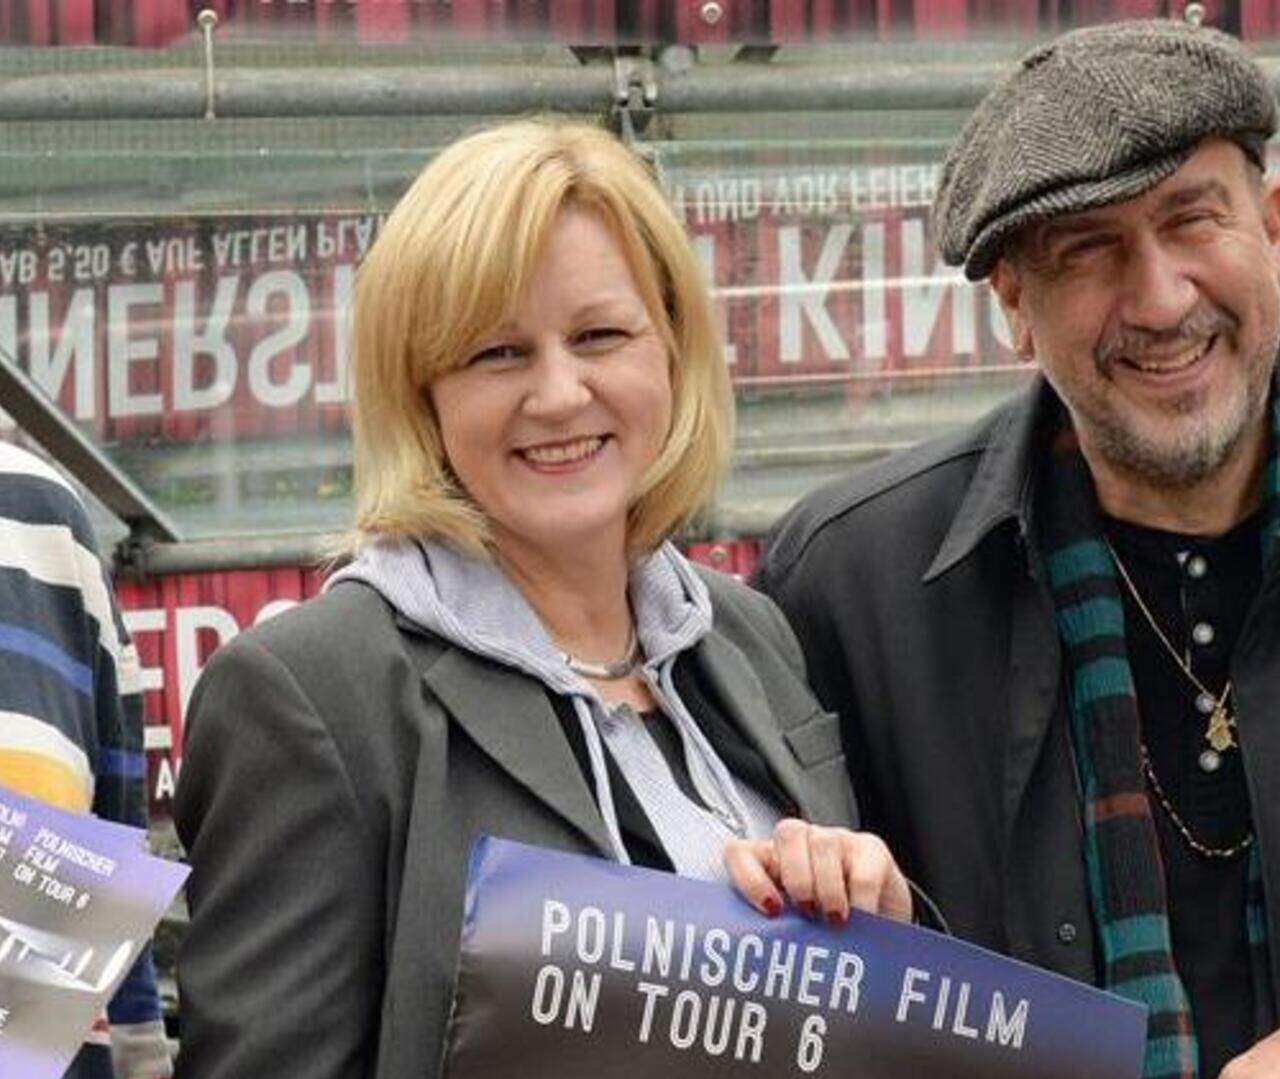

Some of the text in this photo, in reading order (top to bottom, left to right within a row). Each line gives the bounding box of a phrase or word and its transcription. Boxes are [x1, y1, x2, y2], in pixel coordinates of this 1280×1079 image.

[531, 964, 828, 1073] ON TOUR 6
[541, 899, 1031, 1050] POLNISCHER FILM
